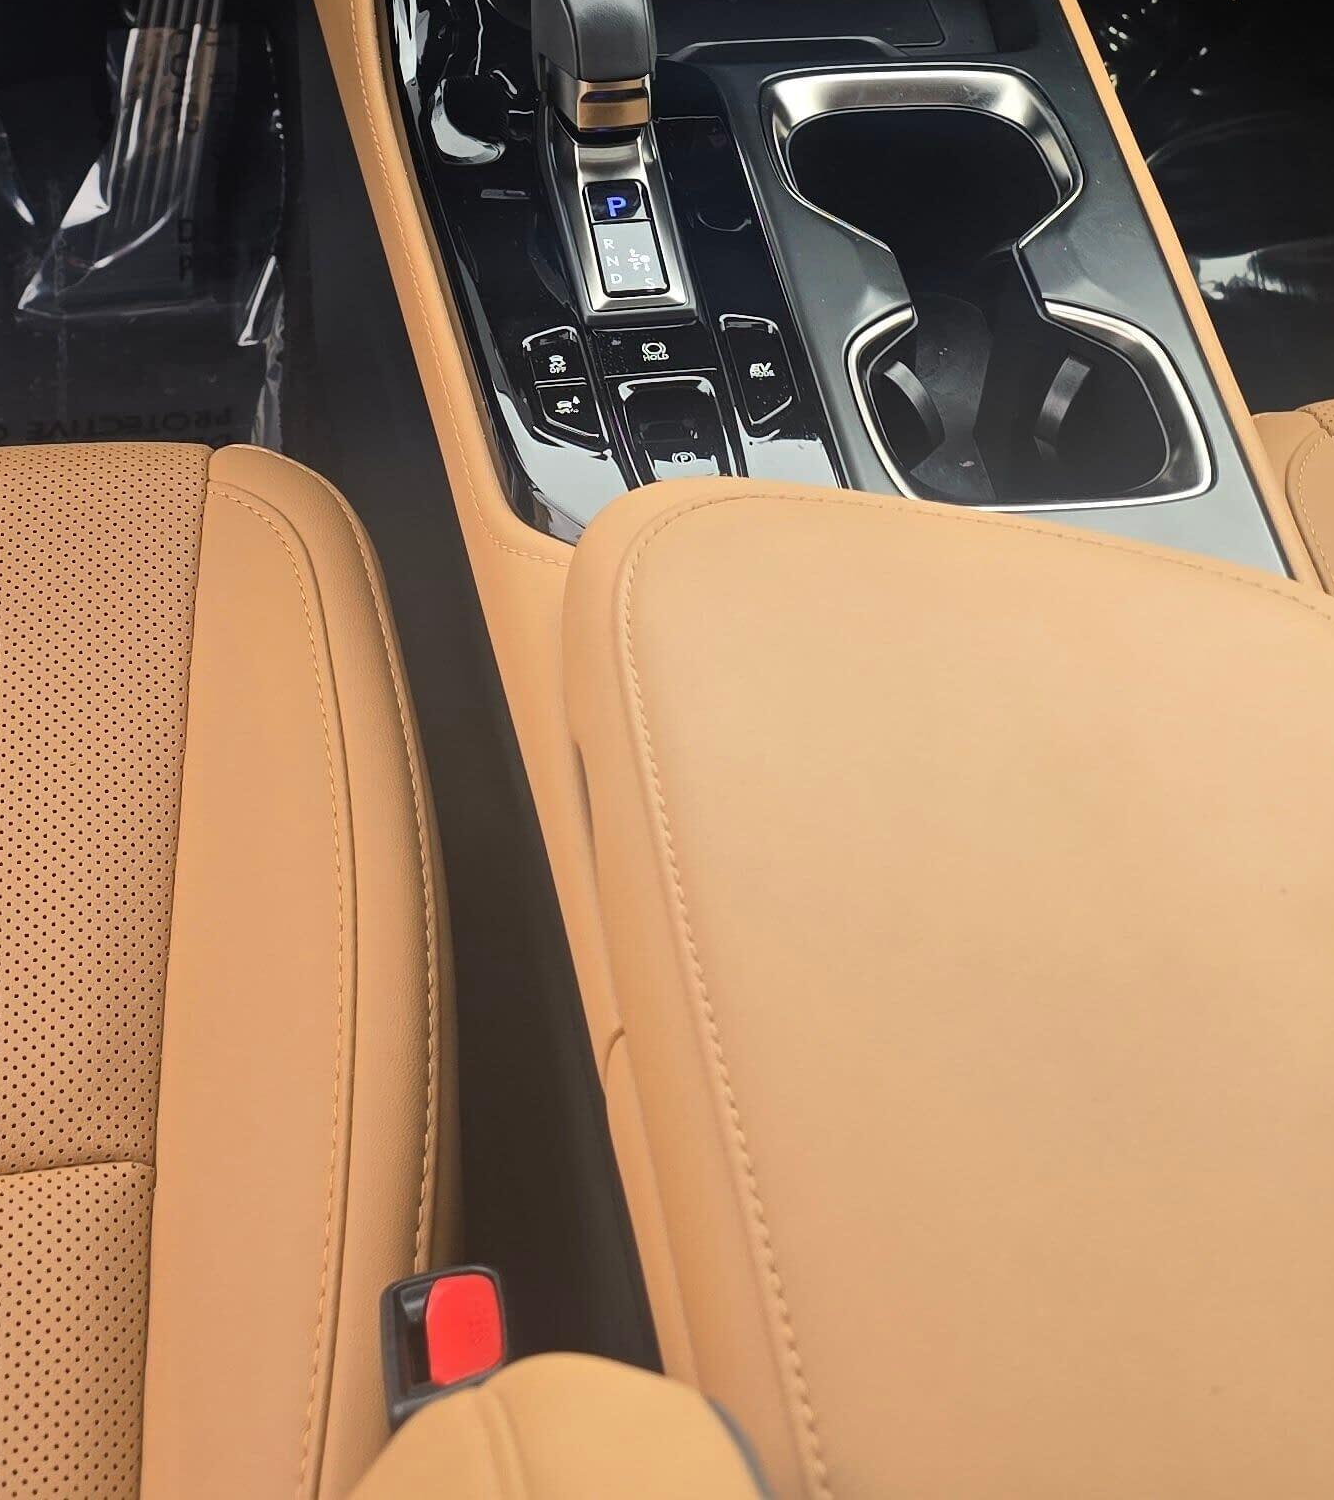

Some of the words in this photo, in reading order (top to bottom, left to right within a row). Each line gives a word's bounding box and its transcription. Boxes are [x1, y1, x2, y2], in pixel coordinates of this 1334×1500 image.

[606, 196, 627, 217] P
[603, 238, 615, 250] R
[606, 256, 619, 267] N
[611, 274, 623, 284] D
[644, 277, 656, 287] S
[642, 352, 670, 362] HOLD
[549, 365, 566, 374] OFF
[750, 362, 772, 372] EV
